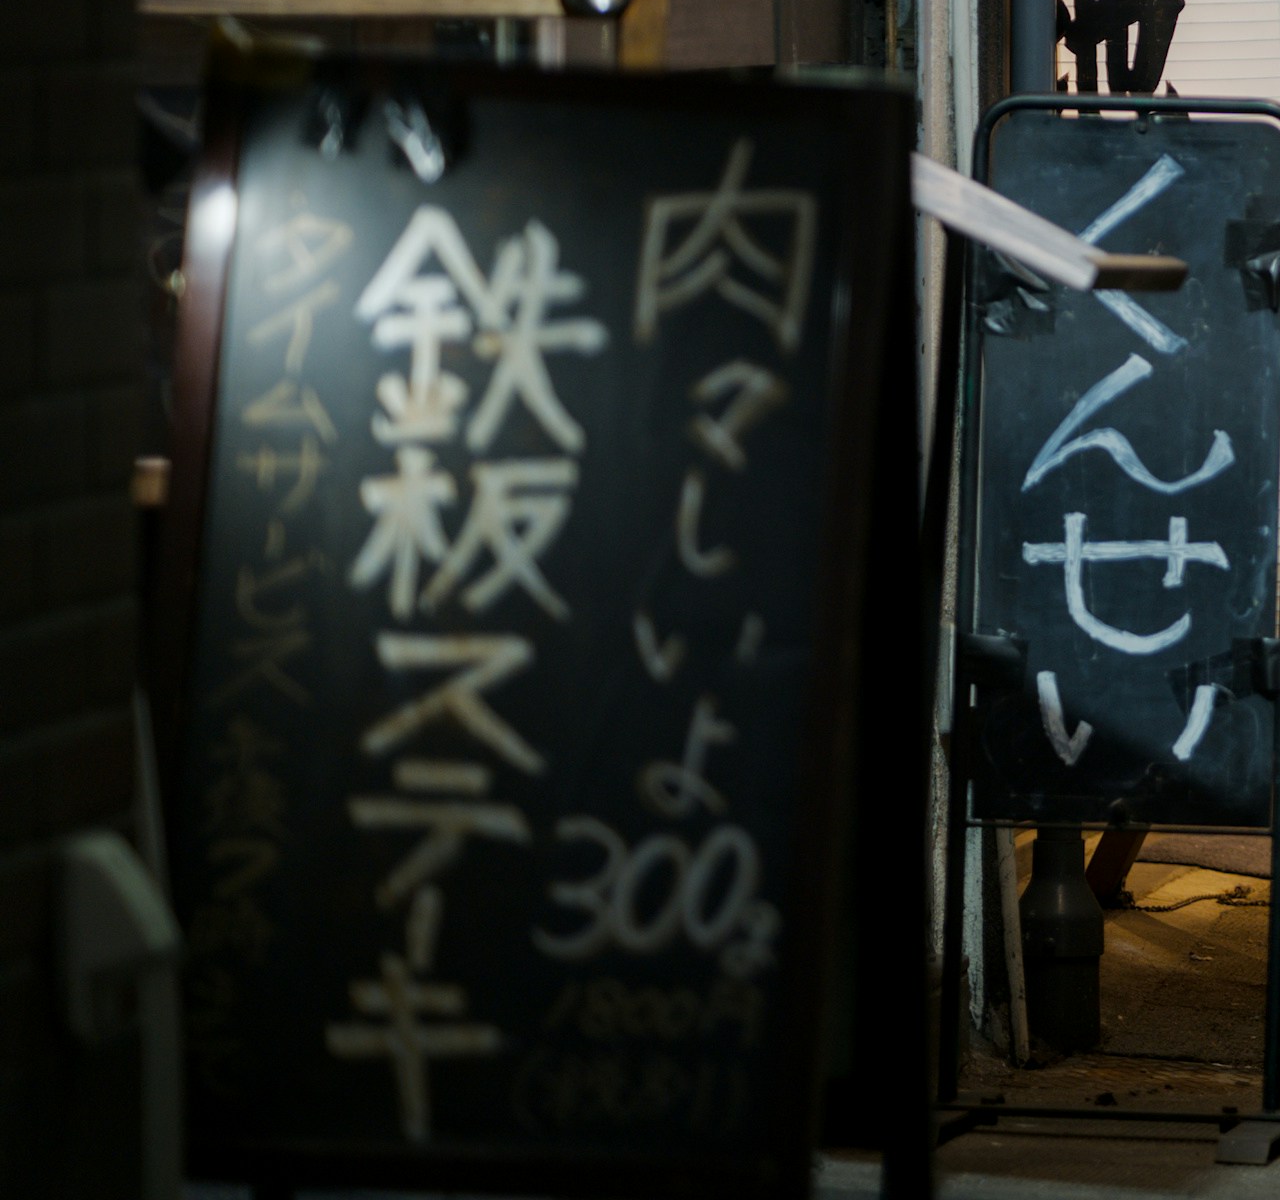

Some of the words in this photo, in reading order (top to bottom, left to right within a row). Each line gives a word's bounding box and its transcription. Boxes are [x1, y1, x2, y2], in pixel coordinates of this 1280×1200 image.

[326, 205, 608, 1141] 鉄板ステーキ
[1022, 155, 1236, 766] くんせい
